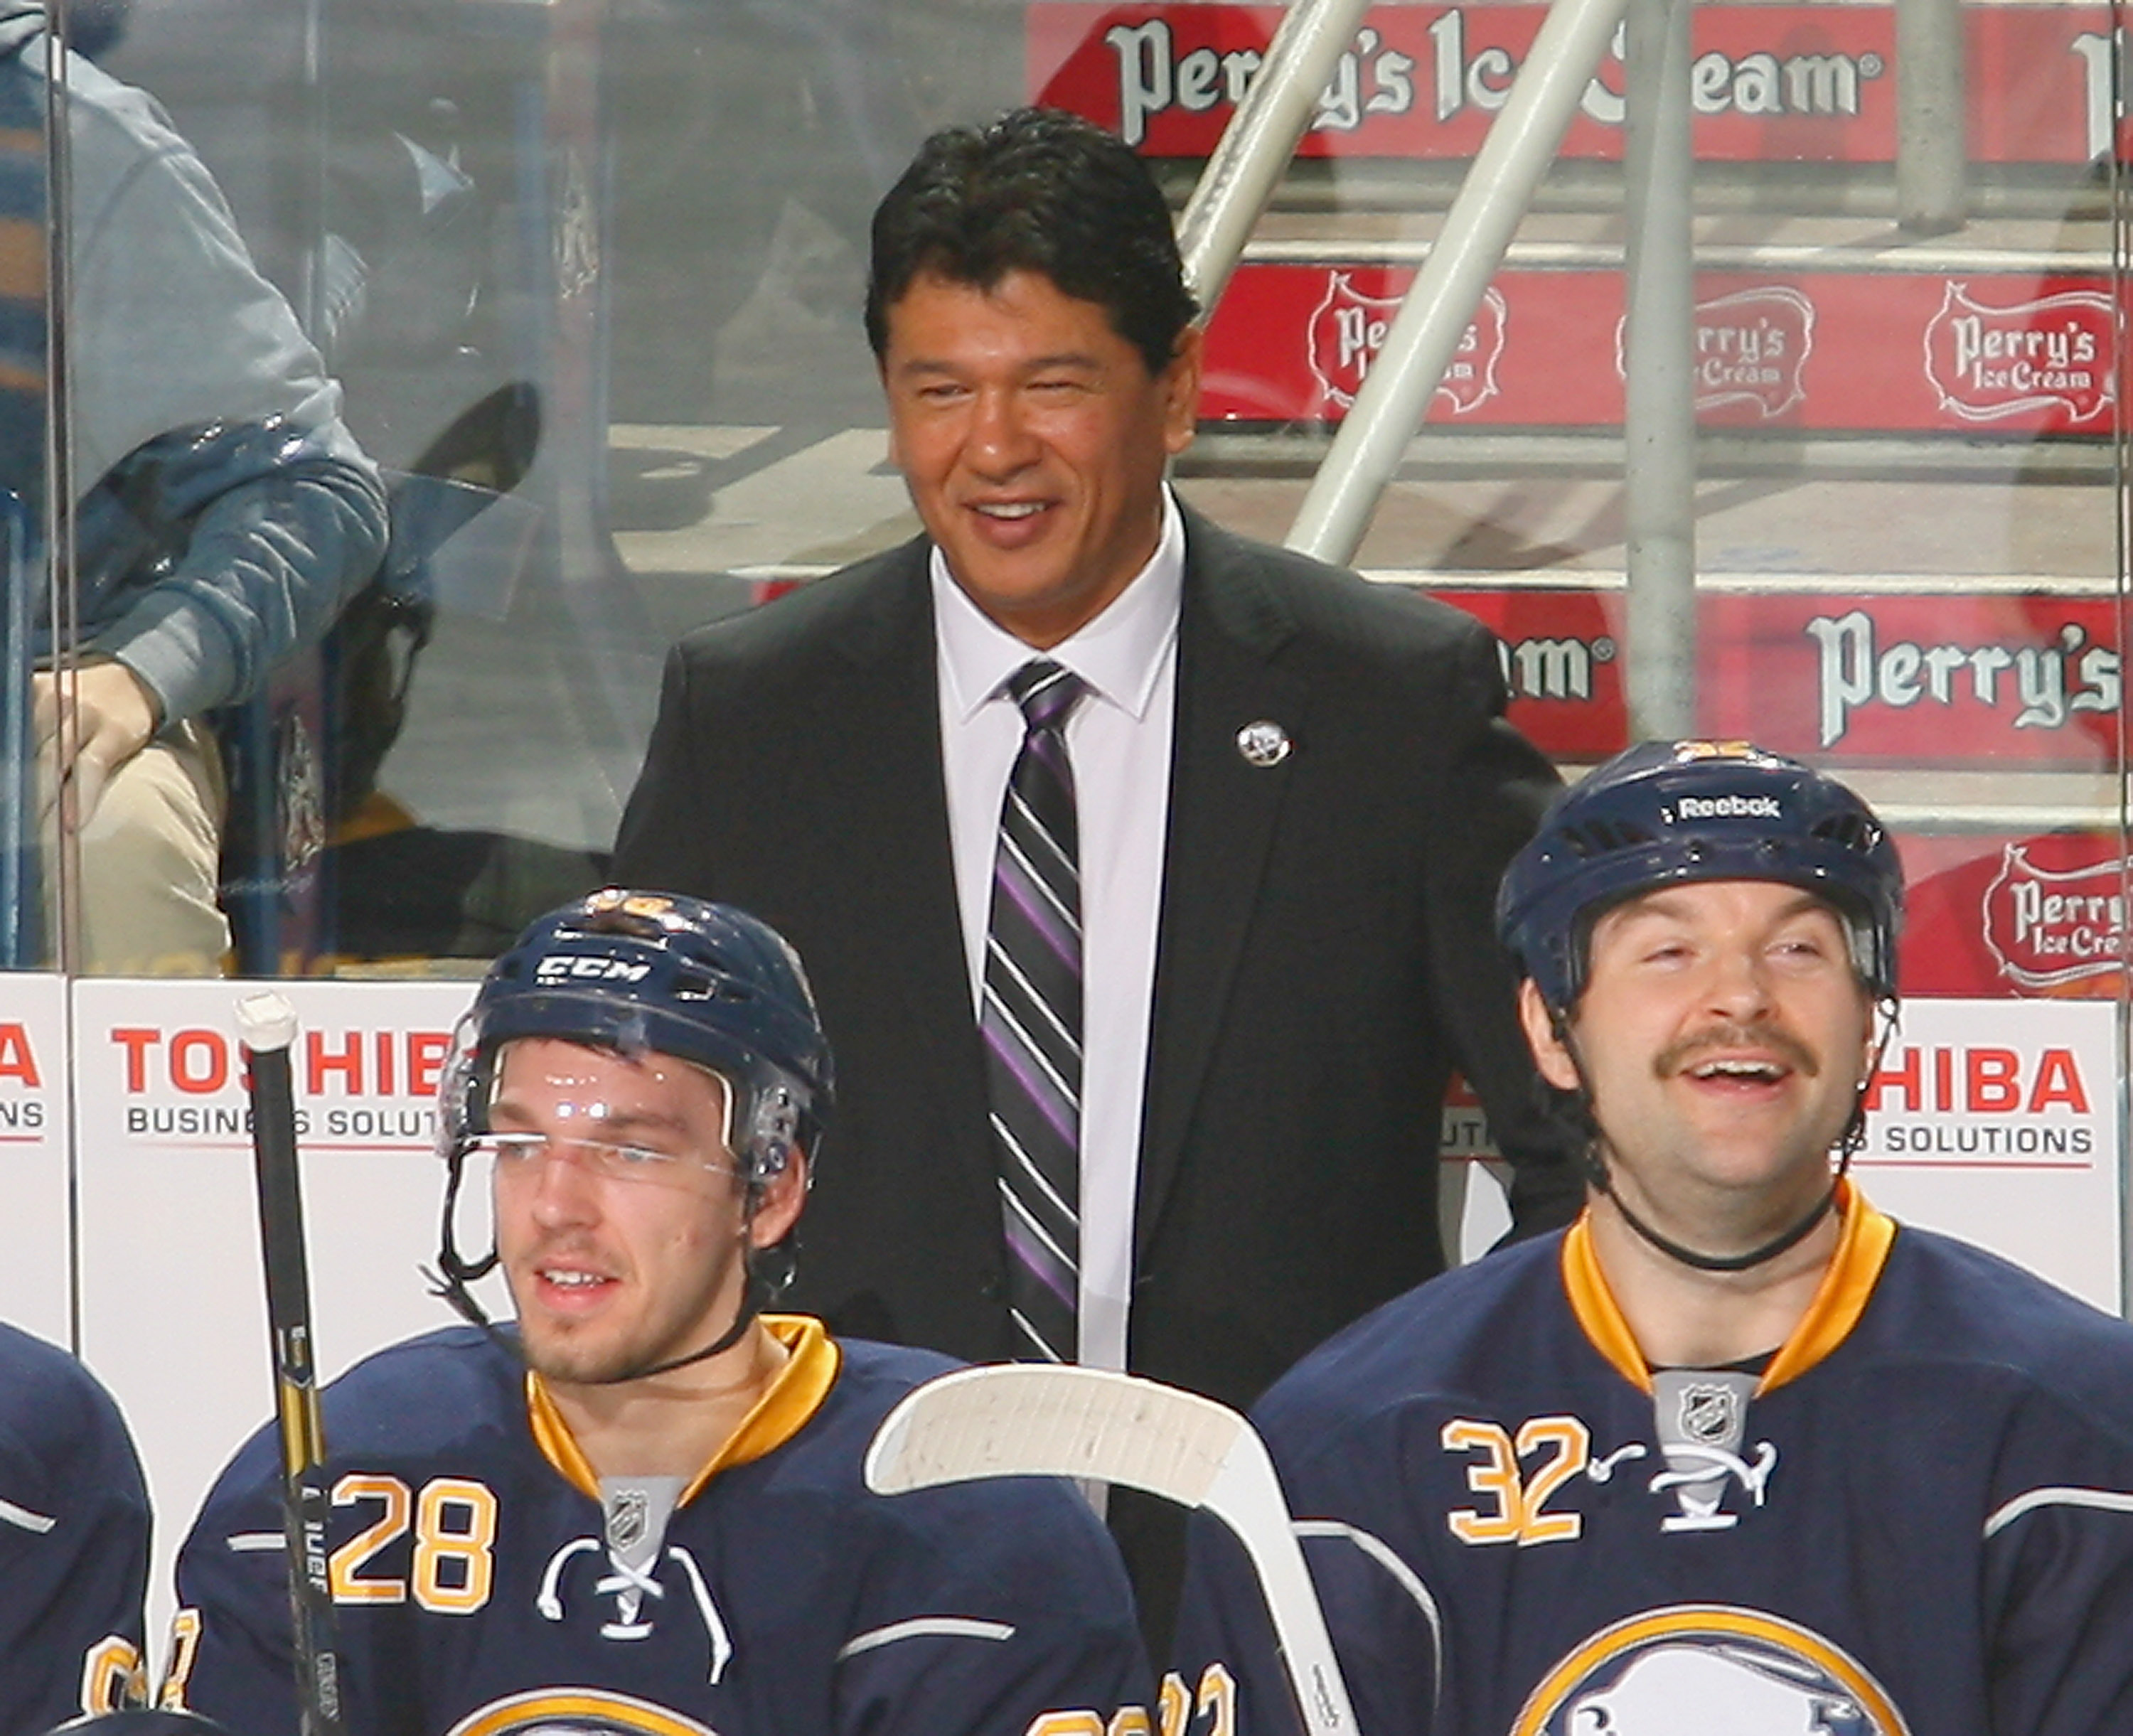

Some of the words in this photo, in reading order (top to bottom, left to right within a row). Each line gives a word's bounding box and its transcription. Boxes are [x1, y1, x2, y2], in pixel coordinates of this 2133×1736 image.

[1105, 18, 1414, 145] Pery's
[1426, 8, 1512, 122] Ic
[1696, 316, 1785, 364] rry's
[1951, 315, 2095, 378] Perry's
[1807, 610, 2120, 749] Perry's
[1678, 795, 1781, 819] Reebok
[537, 956, 651, 982] CCM
[111, 1029, 481, 1096] TOHIB
[1860, 1047, 2091, 1113] HIBA
[127, 1107, 310, 1135] BUSINS
[1886, 1127, 2093, 1153] SOLUTIONS
[1440, 1416, 1587, 1547] 32
[328, 1474, 497, 1615] 28
